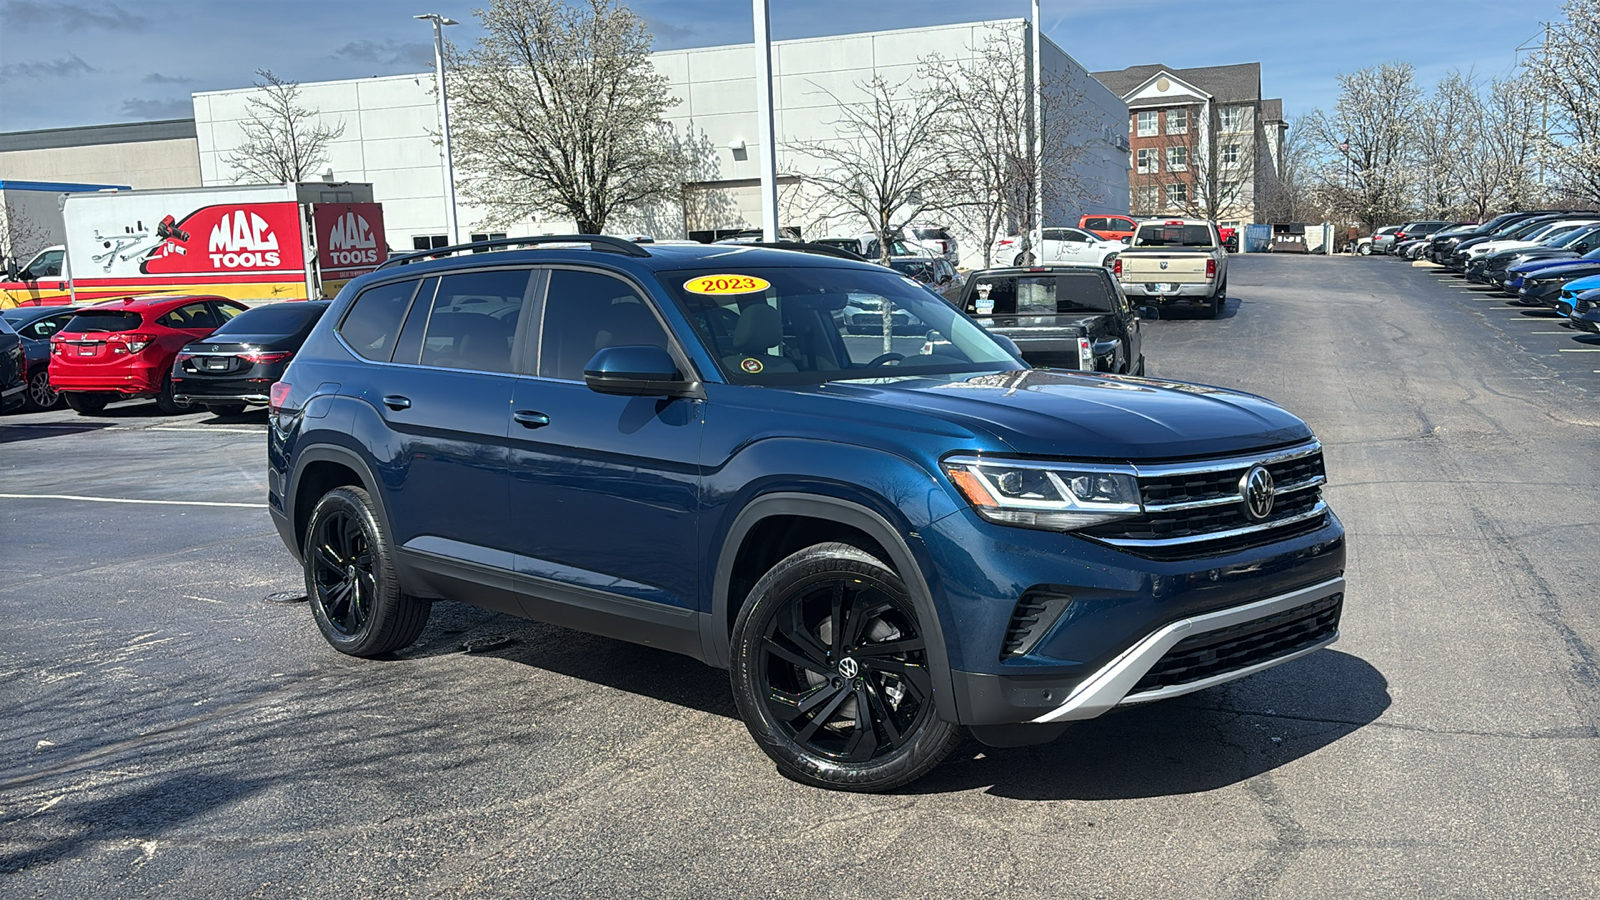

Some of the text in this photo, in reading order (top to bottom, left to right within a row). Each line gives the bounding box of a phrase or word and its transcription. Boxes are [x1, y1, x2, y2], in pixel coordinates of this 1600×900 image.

[209, 210, 280, 252] MAC
[330, 212, 377, 250] MAC
[209, 252, 281, 268] TOOLS
[330, 250, 378, 265] TOOLS
[701, 278, 756, 292] 2023
